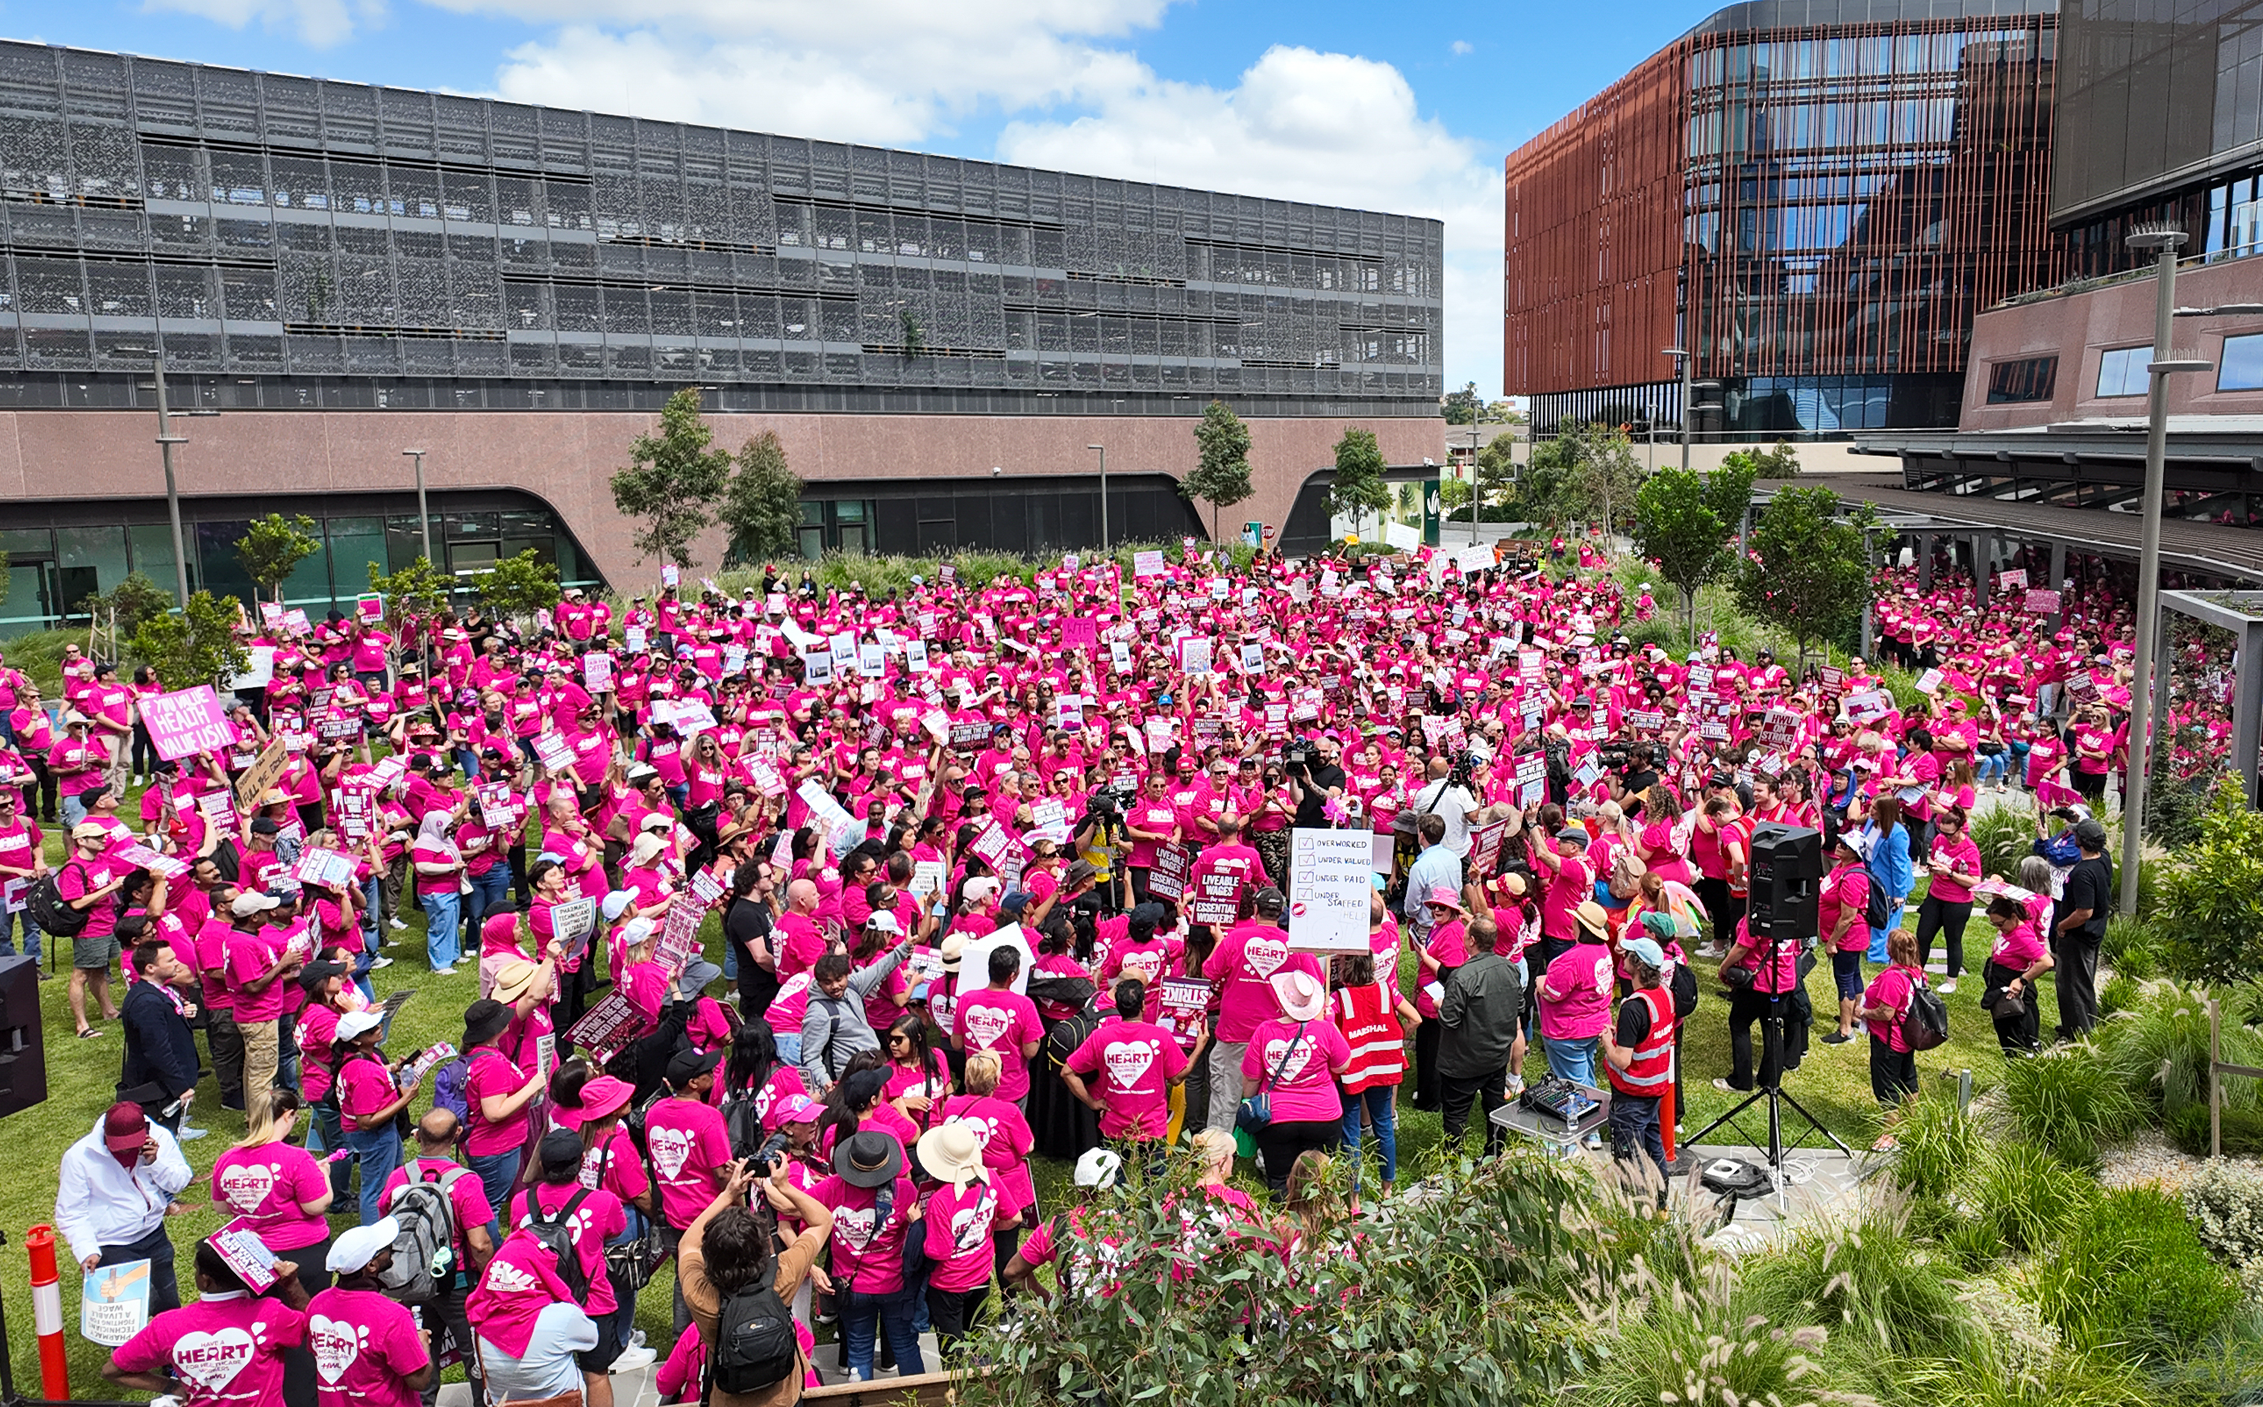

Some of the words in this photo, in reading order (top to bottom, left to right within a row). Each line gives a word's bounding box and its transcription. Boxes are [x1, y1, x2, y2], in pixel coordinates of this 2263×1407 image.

[140, 701, 152, 717] IF
[153, 697, 178, 714] YOU
[174, 688, 209, 710] VALUE
[153, 703, 211, 735] HEALTH
[1772, 713, 1793, 725] HWU
[1700, 725, 1728, 735] STRIKE
[1773, 723, 1786, 733] ON
[158, 732, 200, 757] VALUE
[196, 721, 232, 749] US!!
[1761, 731, 1793, 743] STRIKE
[1317, 840, 1367, 848] OVERWORKED
[1156, 847, 1185, 867] LIVEABLE
[1318, 856, 1342, 864] UNDER
[1344, 857, 1370, 866] VALUED
[1159, 858, 1181, 874] WAGES
[1150, 872, 1183, 890] ESSENTIAL
[1202, 875, 1239, 886] LIVEABLE
[1315, 874, 1339, 882] UNDER
[1344, 875, 1365, 884] PAID
[1150, 882, 1182, 899] WORKERS
[1206, 885, 1233, 897] WAGES
[1314, 891, 1339, 899] UNDER
[560, 903, 588, 914] PHARMACY
[1196, 903, 1237, 914] ESSENTIAL
[1327, 898, 1363, 908] STAFFED
[559, 909, 590, 922] TECHNICIANS
[1196, 912, 1234, 924] WORKERS
[1247, 946, 1286, 960] HEART
[1161, 986, 1209, 1005] STRIKE
[933, 1003, 956, 1016] HER
[573, 1030, 591, 1047] IT'S
[583, 1014, 604, 1034] TIME
[598, 1004, 616, 1021] THE
[610, 993, 627, 1010] GOV
[587, 1021, 612, 1044] CARED
[606, 1011, 624, 1028] FOR
[618, 1004, 632, 1018] US
[968, 1015, 1006, 1030] HEART
[1348, 1023, 1388, 1040] MARSHAL
[1107, 1053, 1150, 1064] HEART
[651, 1137, 687, 1155] HEART
[223, 1178, 269, 1189] HEART
[98, 1304, 123, 1312] WAGE
[125, 1310, 131, 1318] A
[90, 1310, 120, 1320] LIVABLE
[102, 1318, 135, 1326] FIGHTING
[91, 1331, 132, 1342] PHARMACY
[312, 1330, 354, 1357] HEART
[177, 1343, 249, 1364] HEART
[186, 1363, 199, 1371] FOR
[200, 1360, 242, 1369] HEALTHCARE
[199, 1366, 230, 1374] WORKERS
